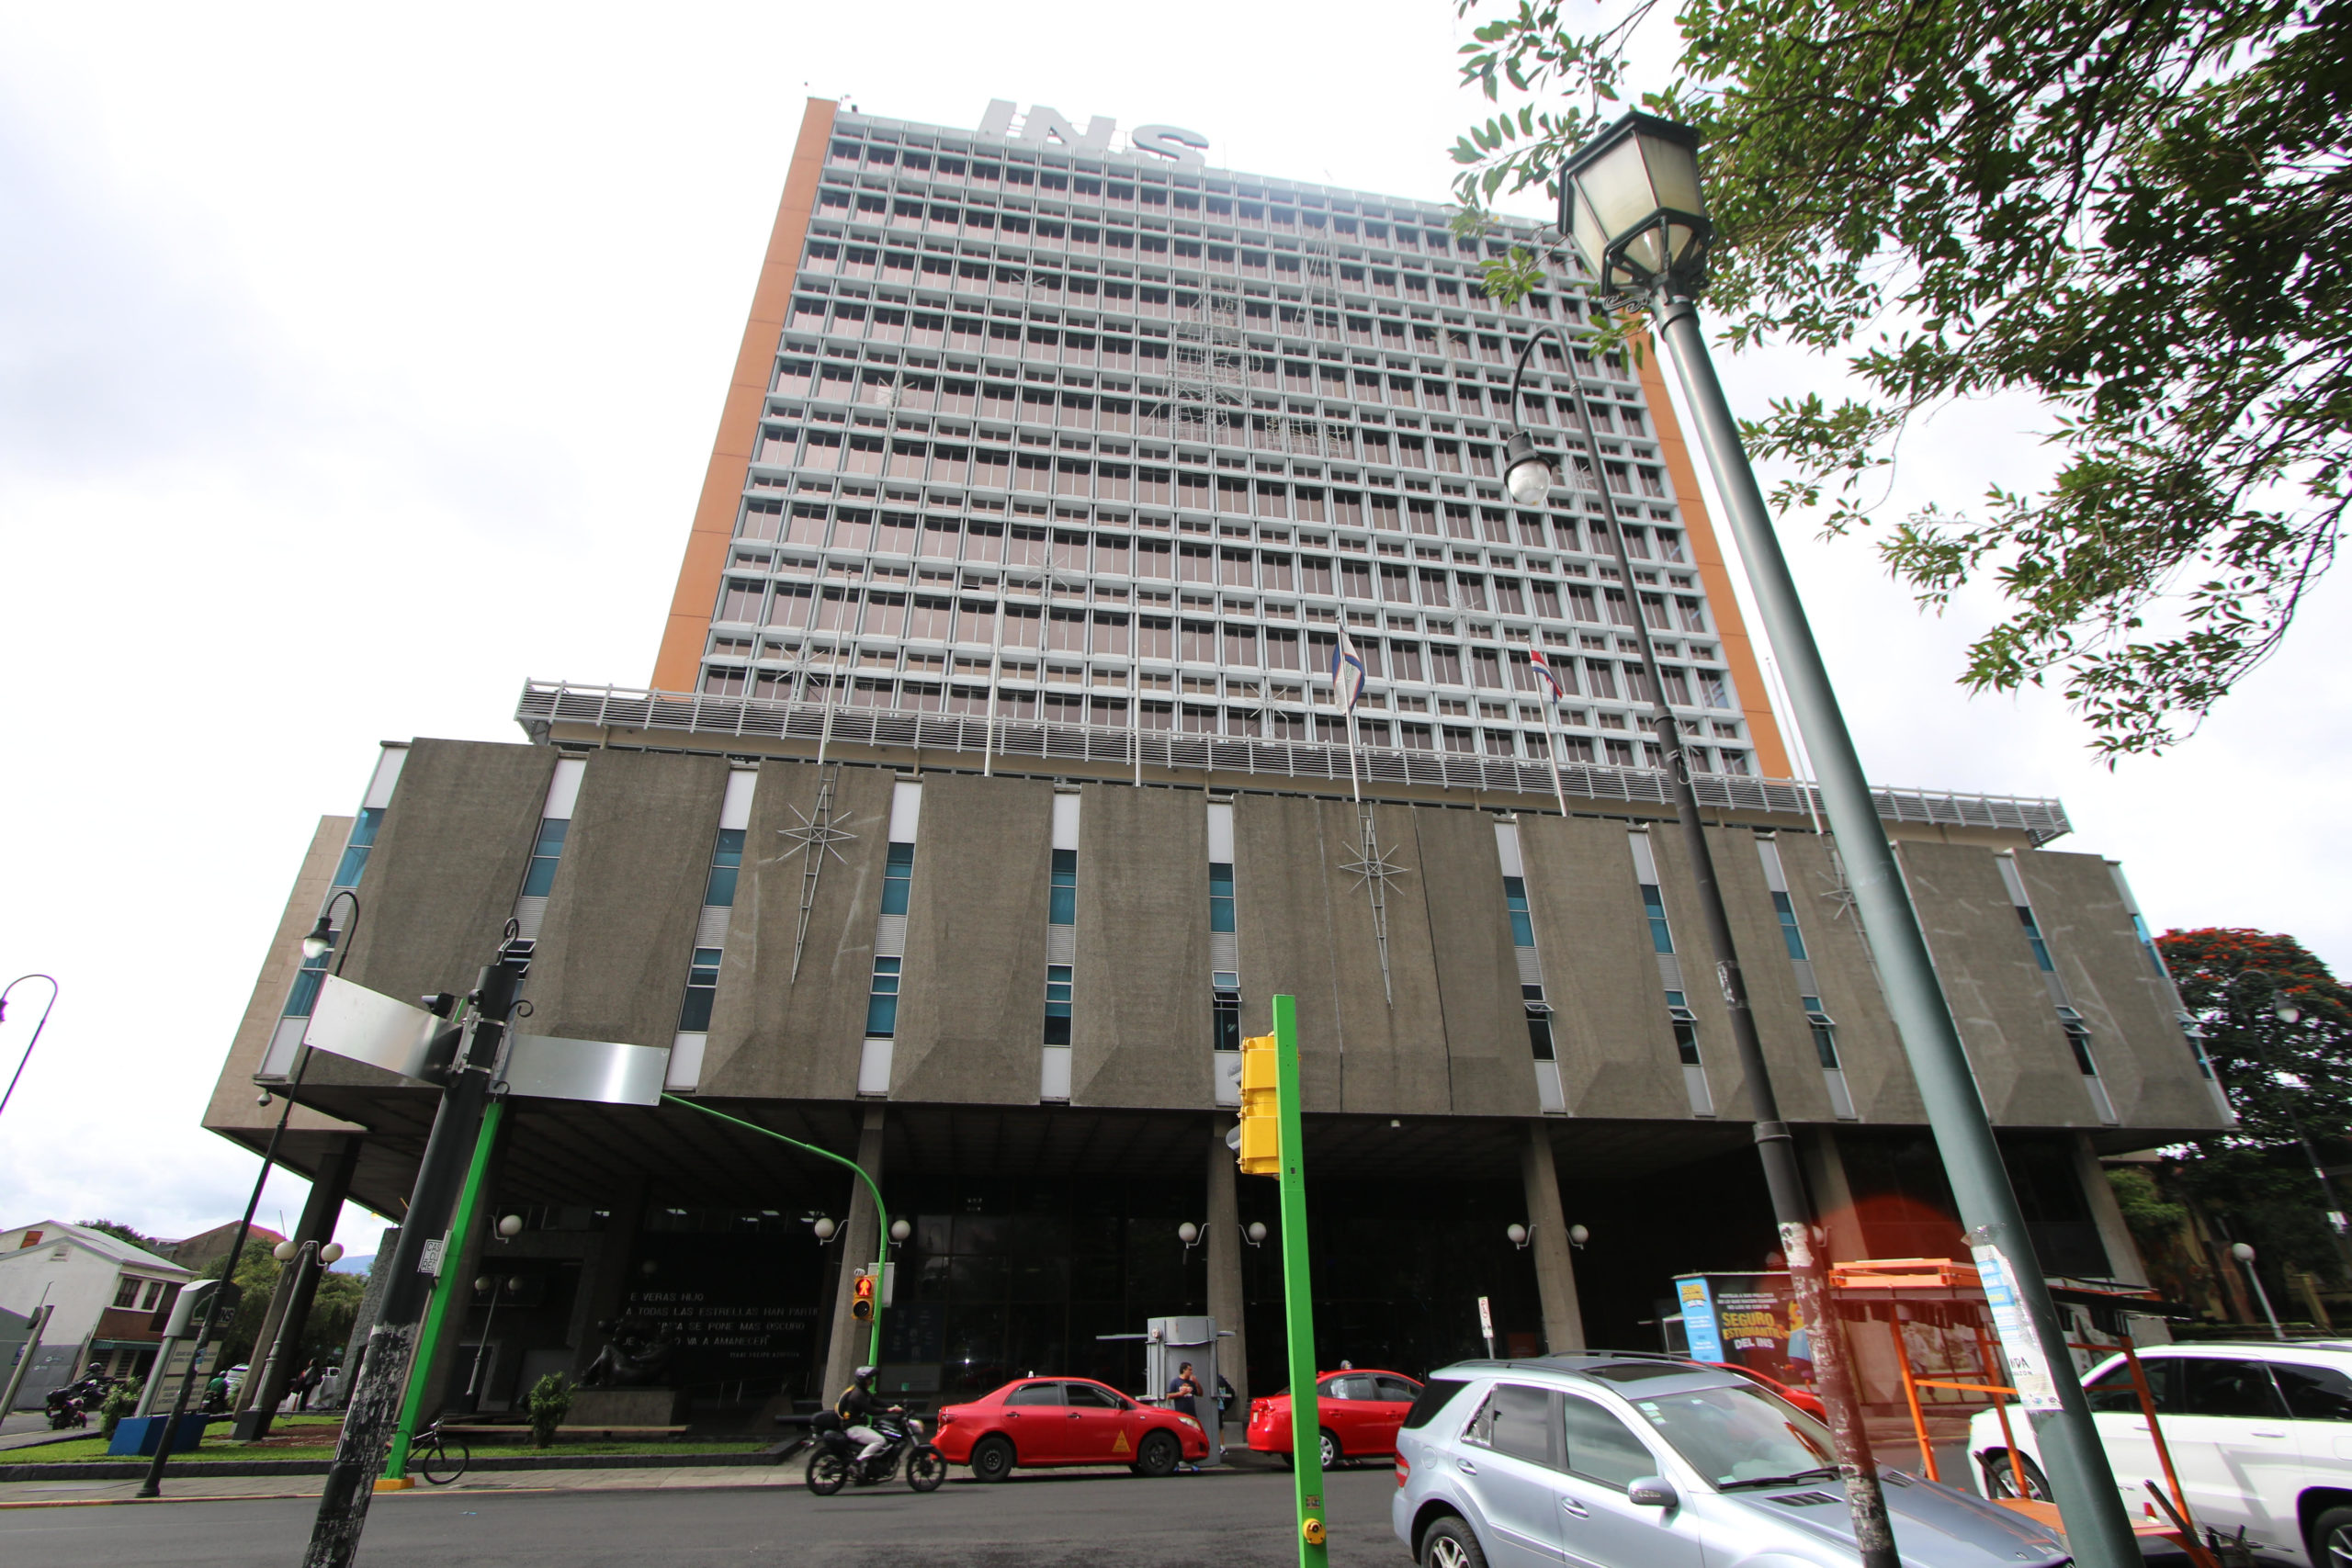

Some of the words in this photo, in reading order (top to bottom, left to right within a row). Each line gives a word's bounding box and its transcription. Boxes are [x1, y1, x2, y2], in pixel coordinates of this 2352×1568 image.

[976, 98, 1210, 168] INS
[642, 1292, 677, 1302] VERAS
[681, 1292, 705, 1302] HIJO
[639, 1307, 670, 1316] TODAS
[673, 1307, 695, 1316] LAS
[698, 1307, 759, 1316] ESTRELLAS
[763, 1307, 786, 1316] HAN
[1721, 1311, 1775, 1327] SEGURO
[707, 1322, 735, 1331] PONE
[740, 1322, 762, 1331] MAS
[765, 1322, 806, 1331] OSCURO
[686, 1337, 698, 1346] VA
[702, 1337, 709, 1346] A
[1733, 1337, 1756, 1350] DEL
[1755, 1337, 1775, 1349] INS
